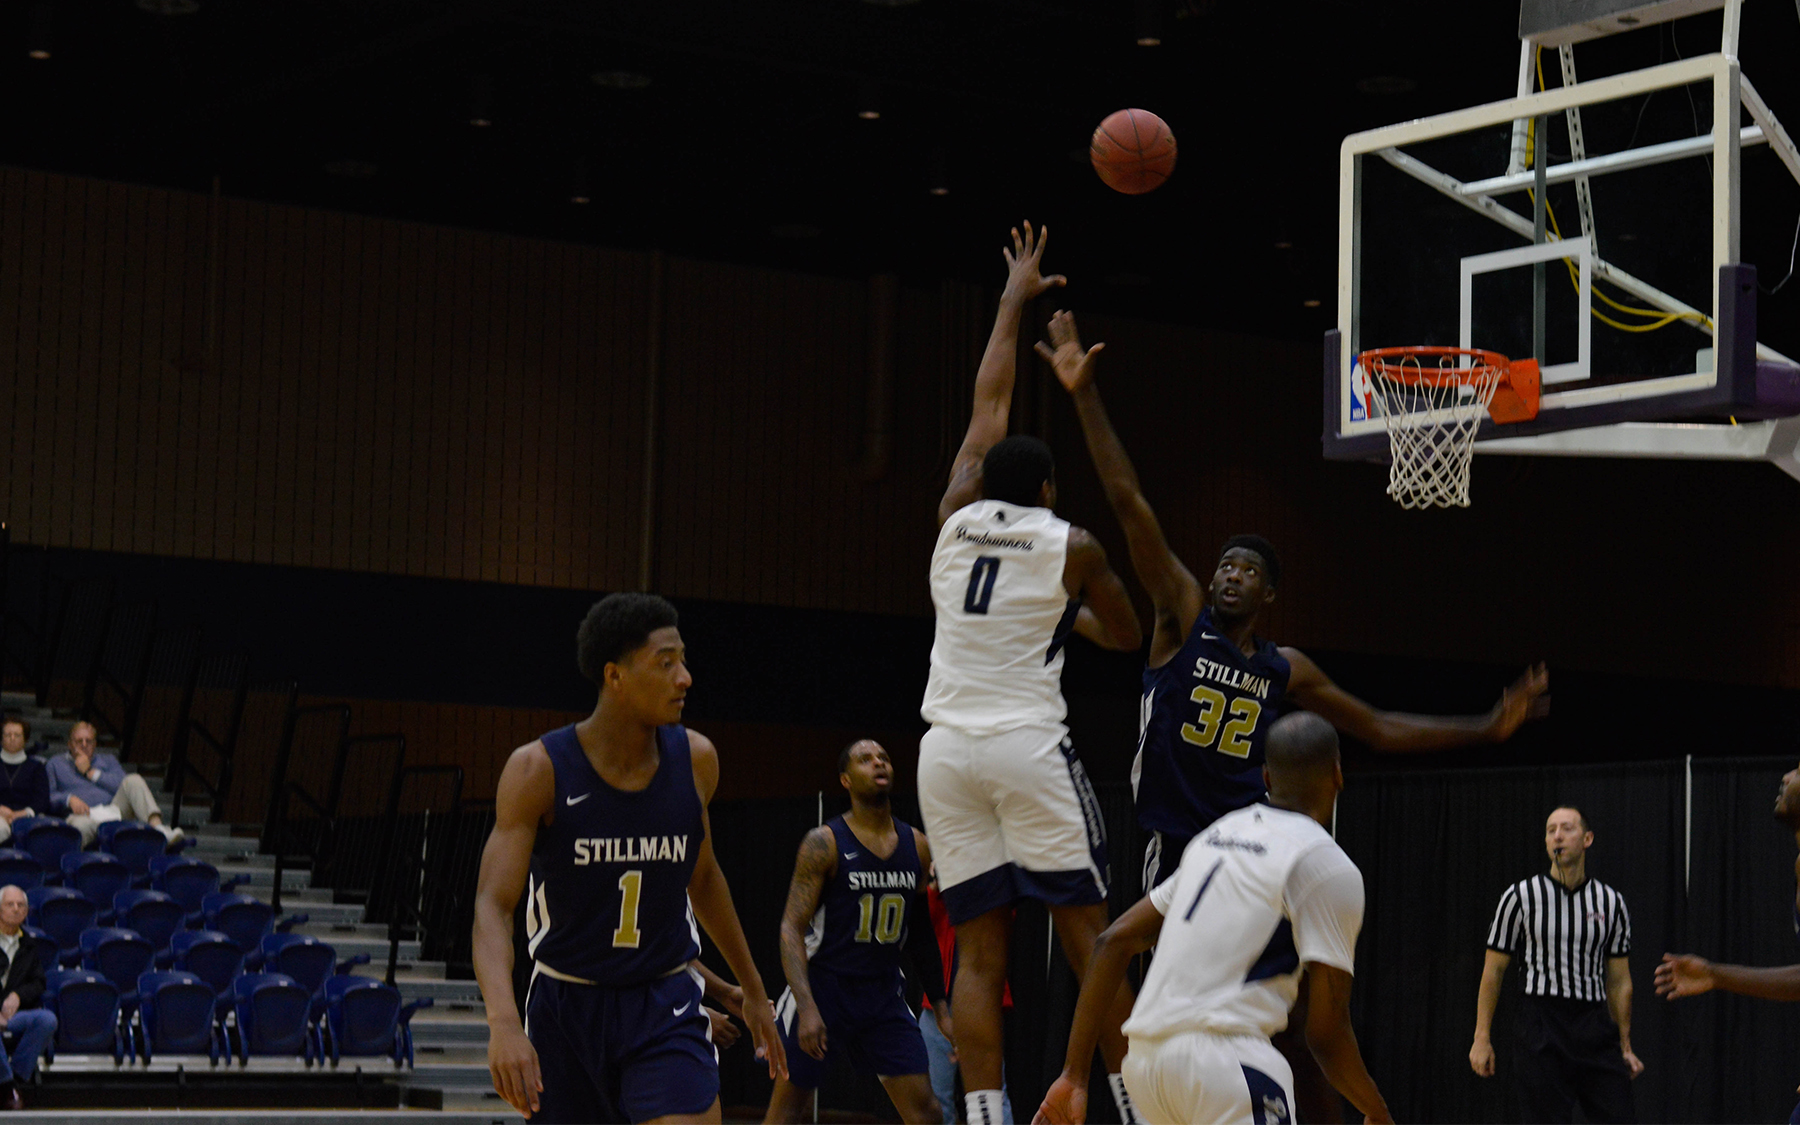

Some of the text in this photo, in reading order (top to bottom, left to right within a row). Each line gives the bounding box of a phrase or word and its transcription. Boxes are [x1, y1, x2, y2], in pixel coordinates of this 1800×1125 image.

[963, 555, 1001, 615] 0
[1192, 656, 1272, 700] STILLMAN
[1180, 684, 1262, 759] 32
[573, 834, 688, 866] STILLMAN
[848, 870, 917, 891] STILLMAN
[611, 869, 643, 949] 1
[853, 893, 906, 945] 10
